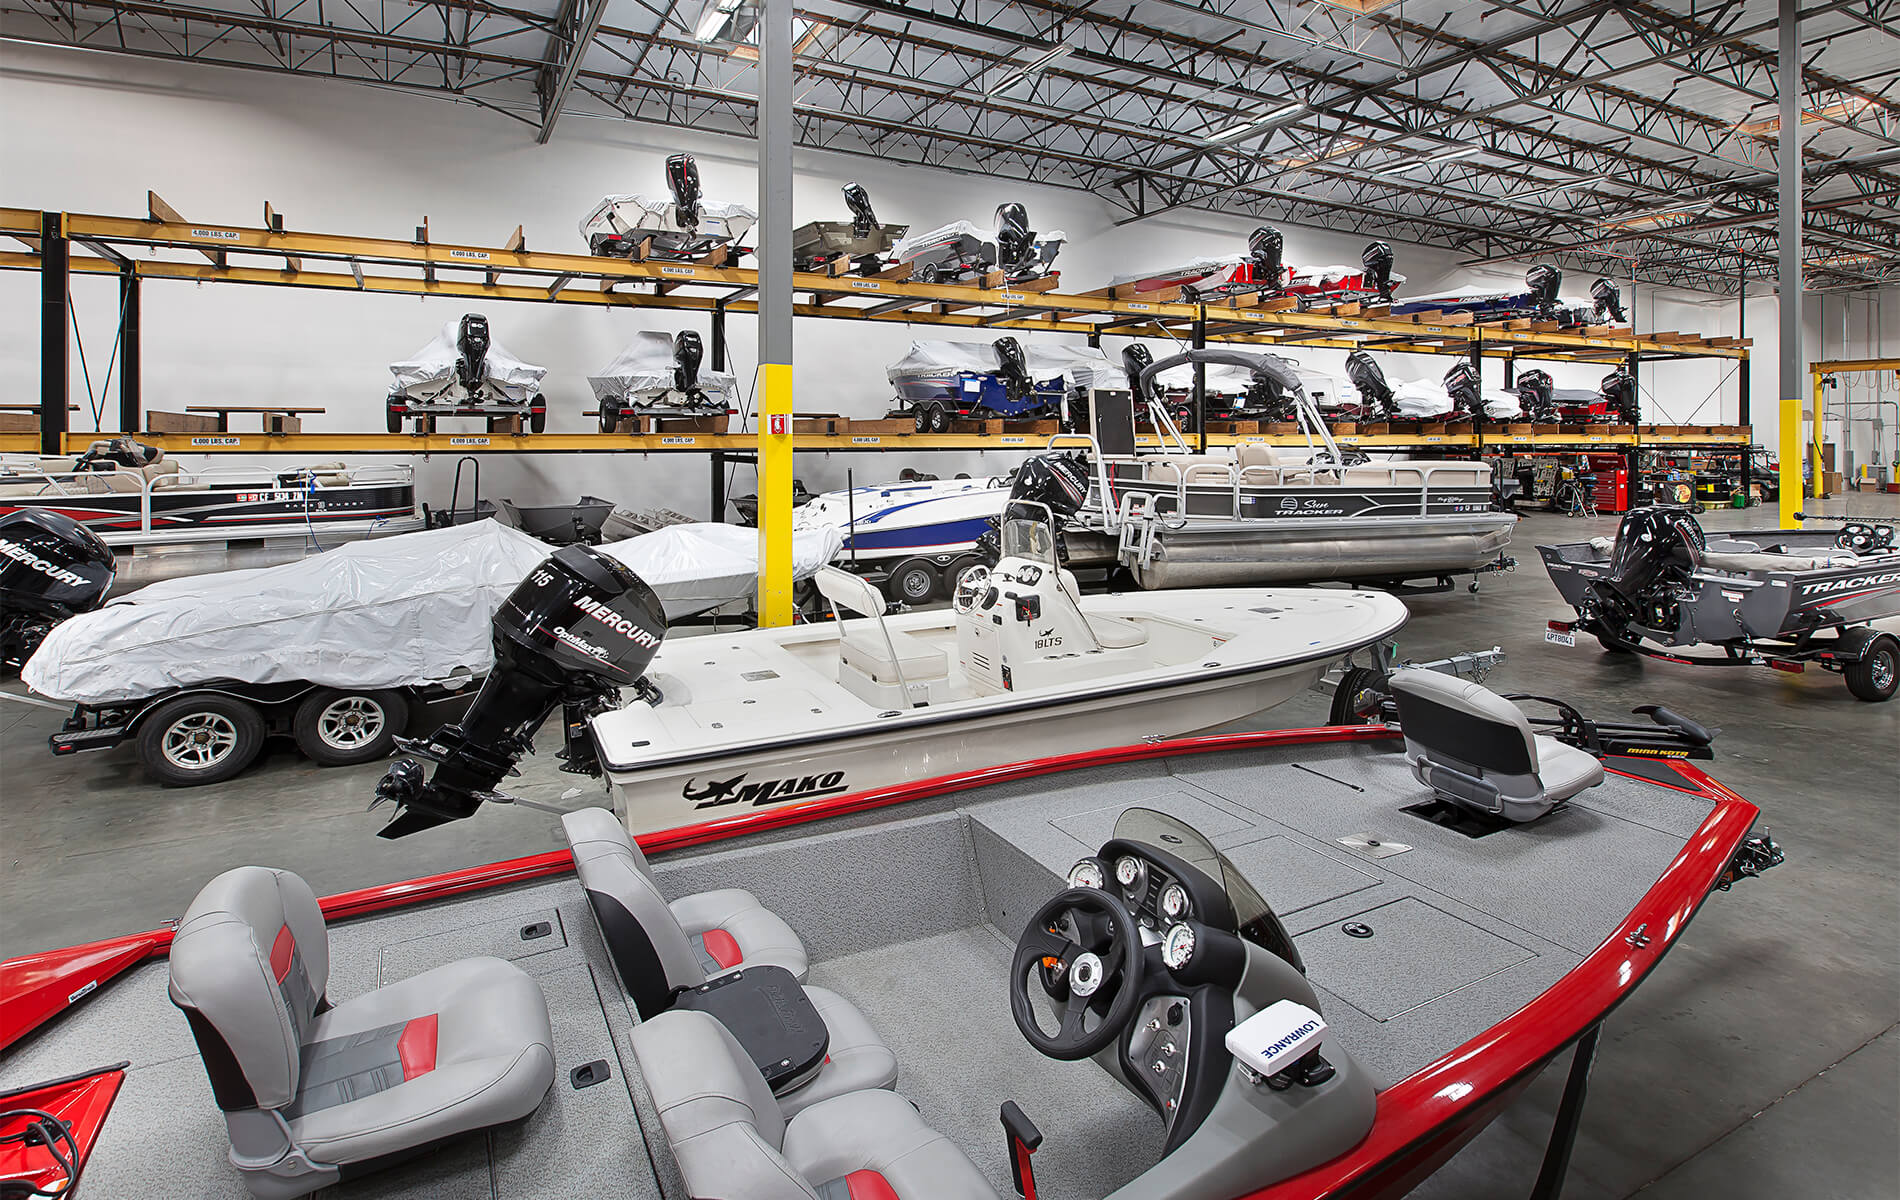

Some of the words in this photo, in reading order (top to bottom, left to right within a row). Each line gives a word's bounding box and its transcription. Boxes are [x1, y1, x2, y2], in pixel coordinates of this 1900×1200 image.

[1053, 461, 1088, 494] MERCURY
[1274, 508, 1344, 516] TRACKER
[1303, 499, 1329, 510] Sun
[0, 538, 93, 588] MERCURY
[530, 568, 555, 588] 115
[1800, 573, 1900, 596] TRACKER
[573, 595, 661, 651] MERCURY
[736, 771, 849, 806] MAKO
[1260, 1019, 1320, 1060] LOWRANCE
